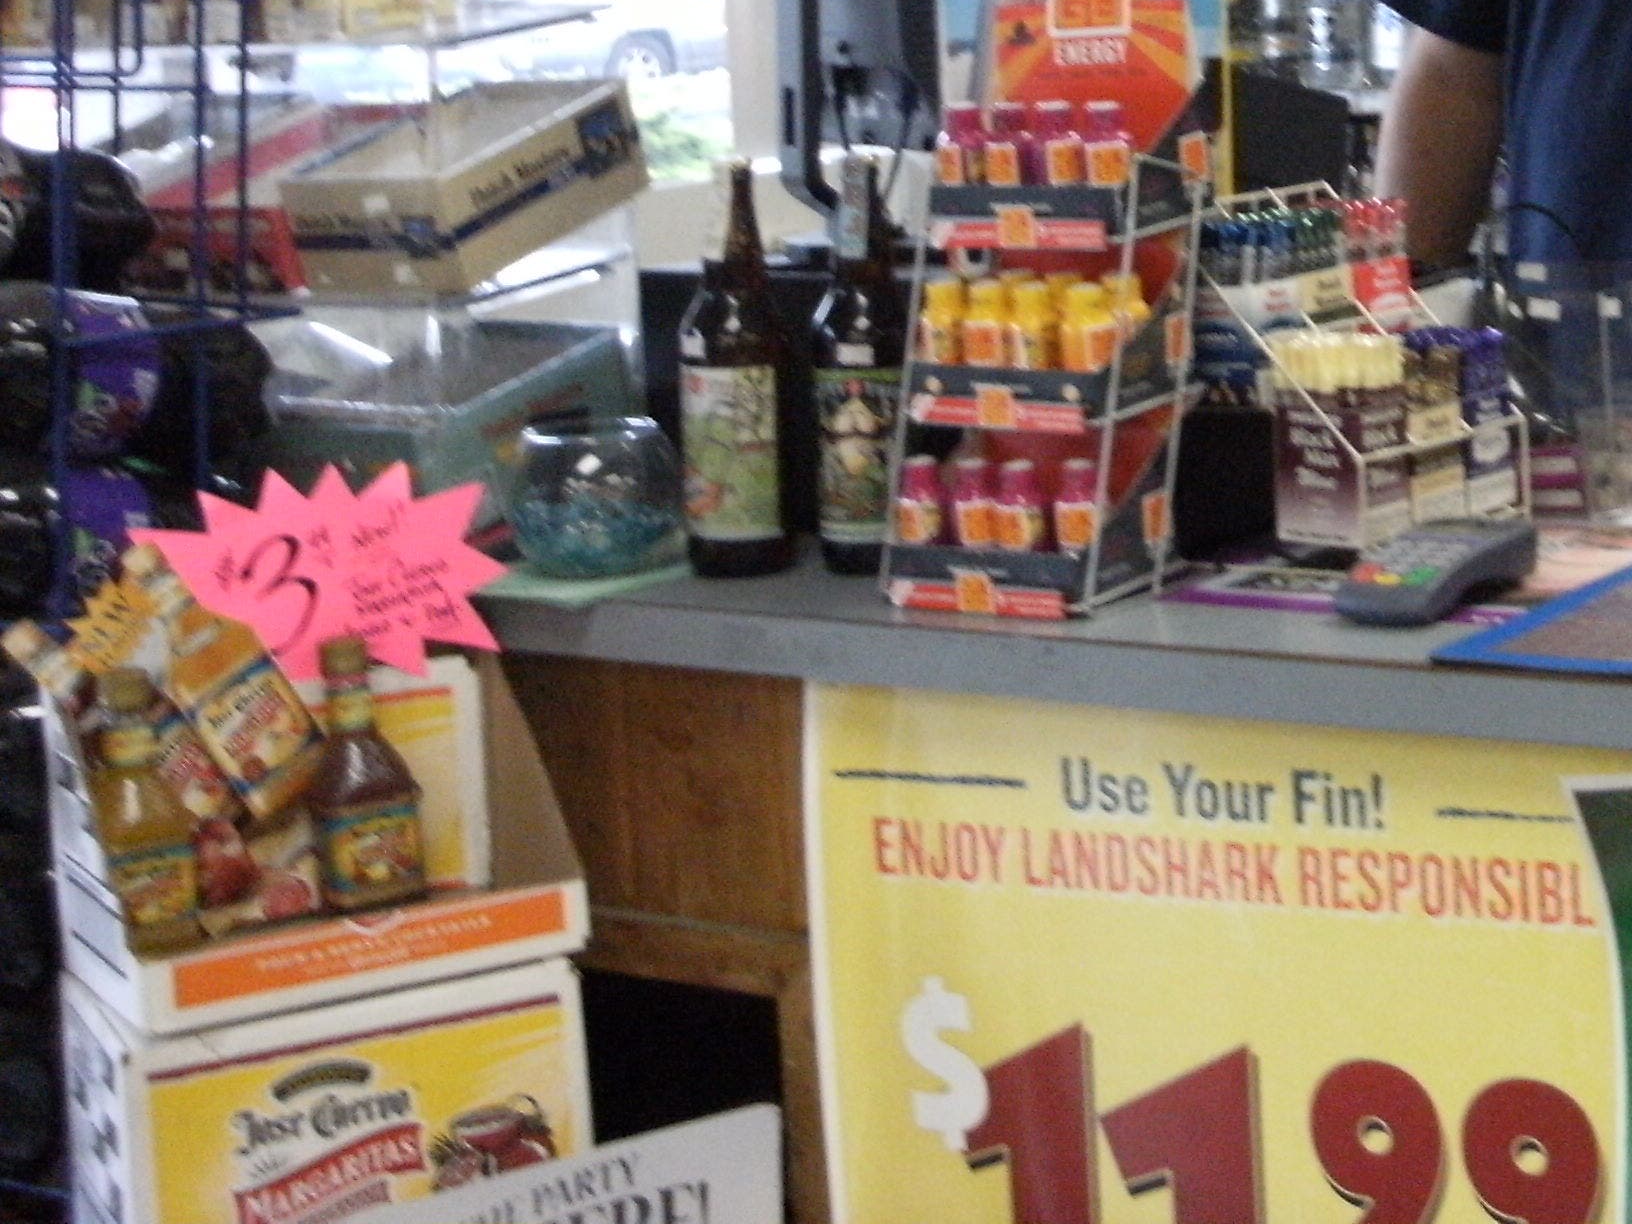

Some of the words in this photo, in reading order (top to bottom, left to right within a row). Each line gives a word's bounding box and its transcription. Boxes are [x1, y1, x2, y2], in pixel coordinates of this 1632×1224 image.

[1060, 756, 1150, 816] Use
[1163, 765, 1271, 823] Your
[1291, 770, 1386, 829] Fin!
[871, 816, 1005, 884] ENJOY
[1022, 827, 1284, 905] LANDSHARK
[1299, 845, 1597, 928] RESPONSIBL
[230, 1110, 304, 1156] Jose
[529, 1150, 643, 1217] PARTY
